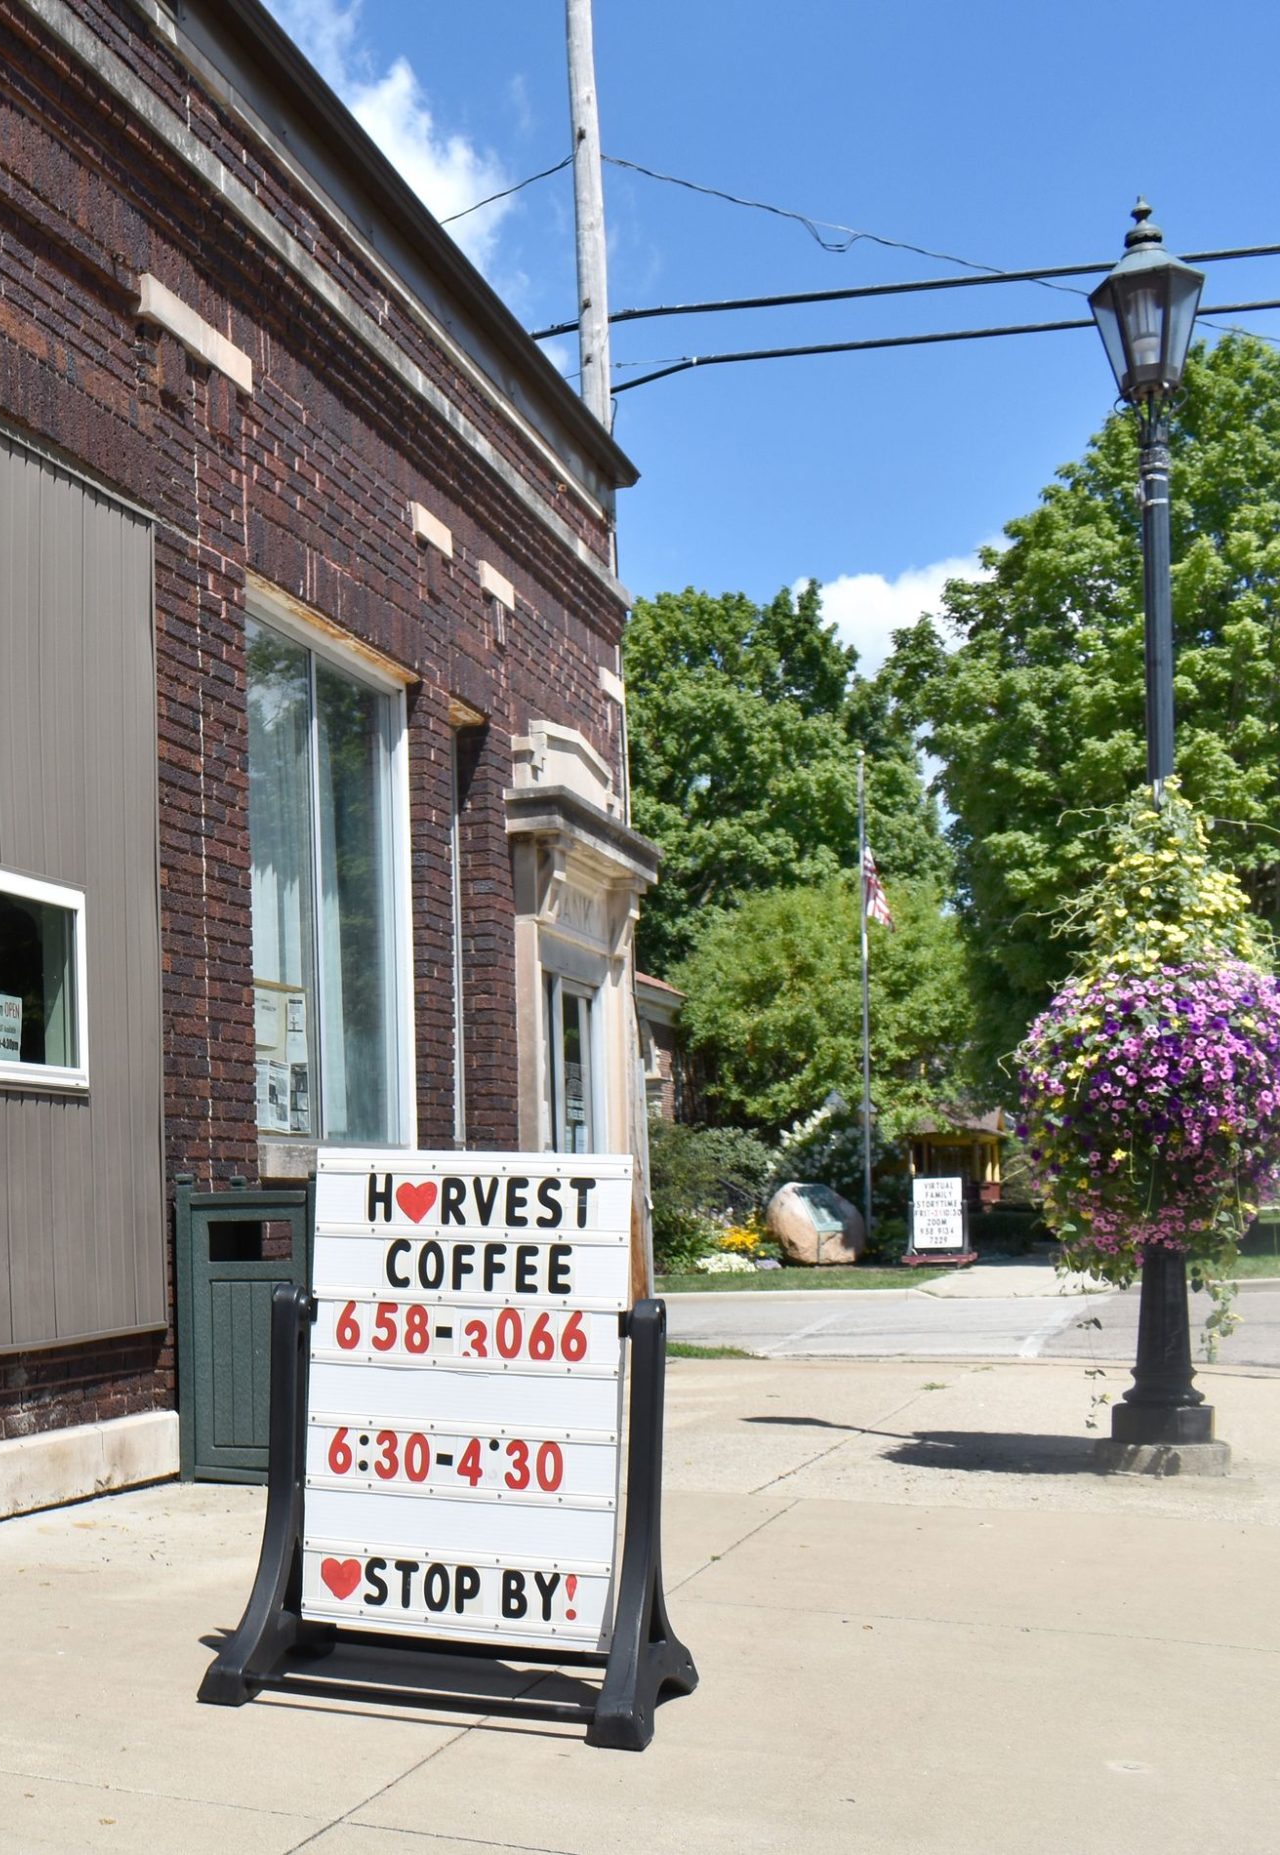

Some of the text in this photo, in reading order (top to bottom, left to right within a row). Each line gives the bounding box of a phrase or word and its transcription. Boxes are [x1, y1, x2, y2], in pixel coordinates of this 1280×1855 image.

[4, 1001, 20, 1019] OPEN
[924, 1182, 954, 1190] VIRTUAL
[925, 1191, 952, 1199] FAMILY
[917, 1200, 958, 1208] STORYTIME
[927, 1218, 948, 1226] ZOOM
[386, 1238, 573, 1294] COFFEE
[335, 1300, 588, 1362] 658-3066
[364, 1557, 579, 1622] STOP BY!
